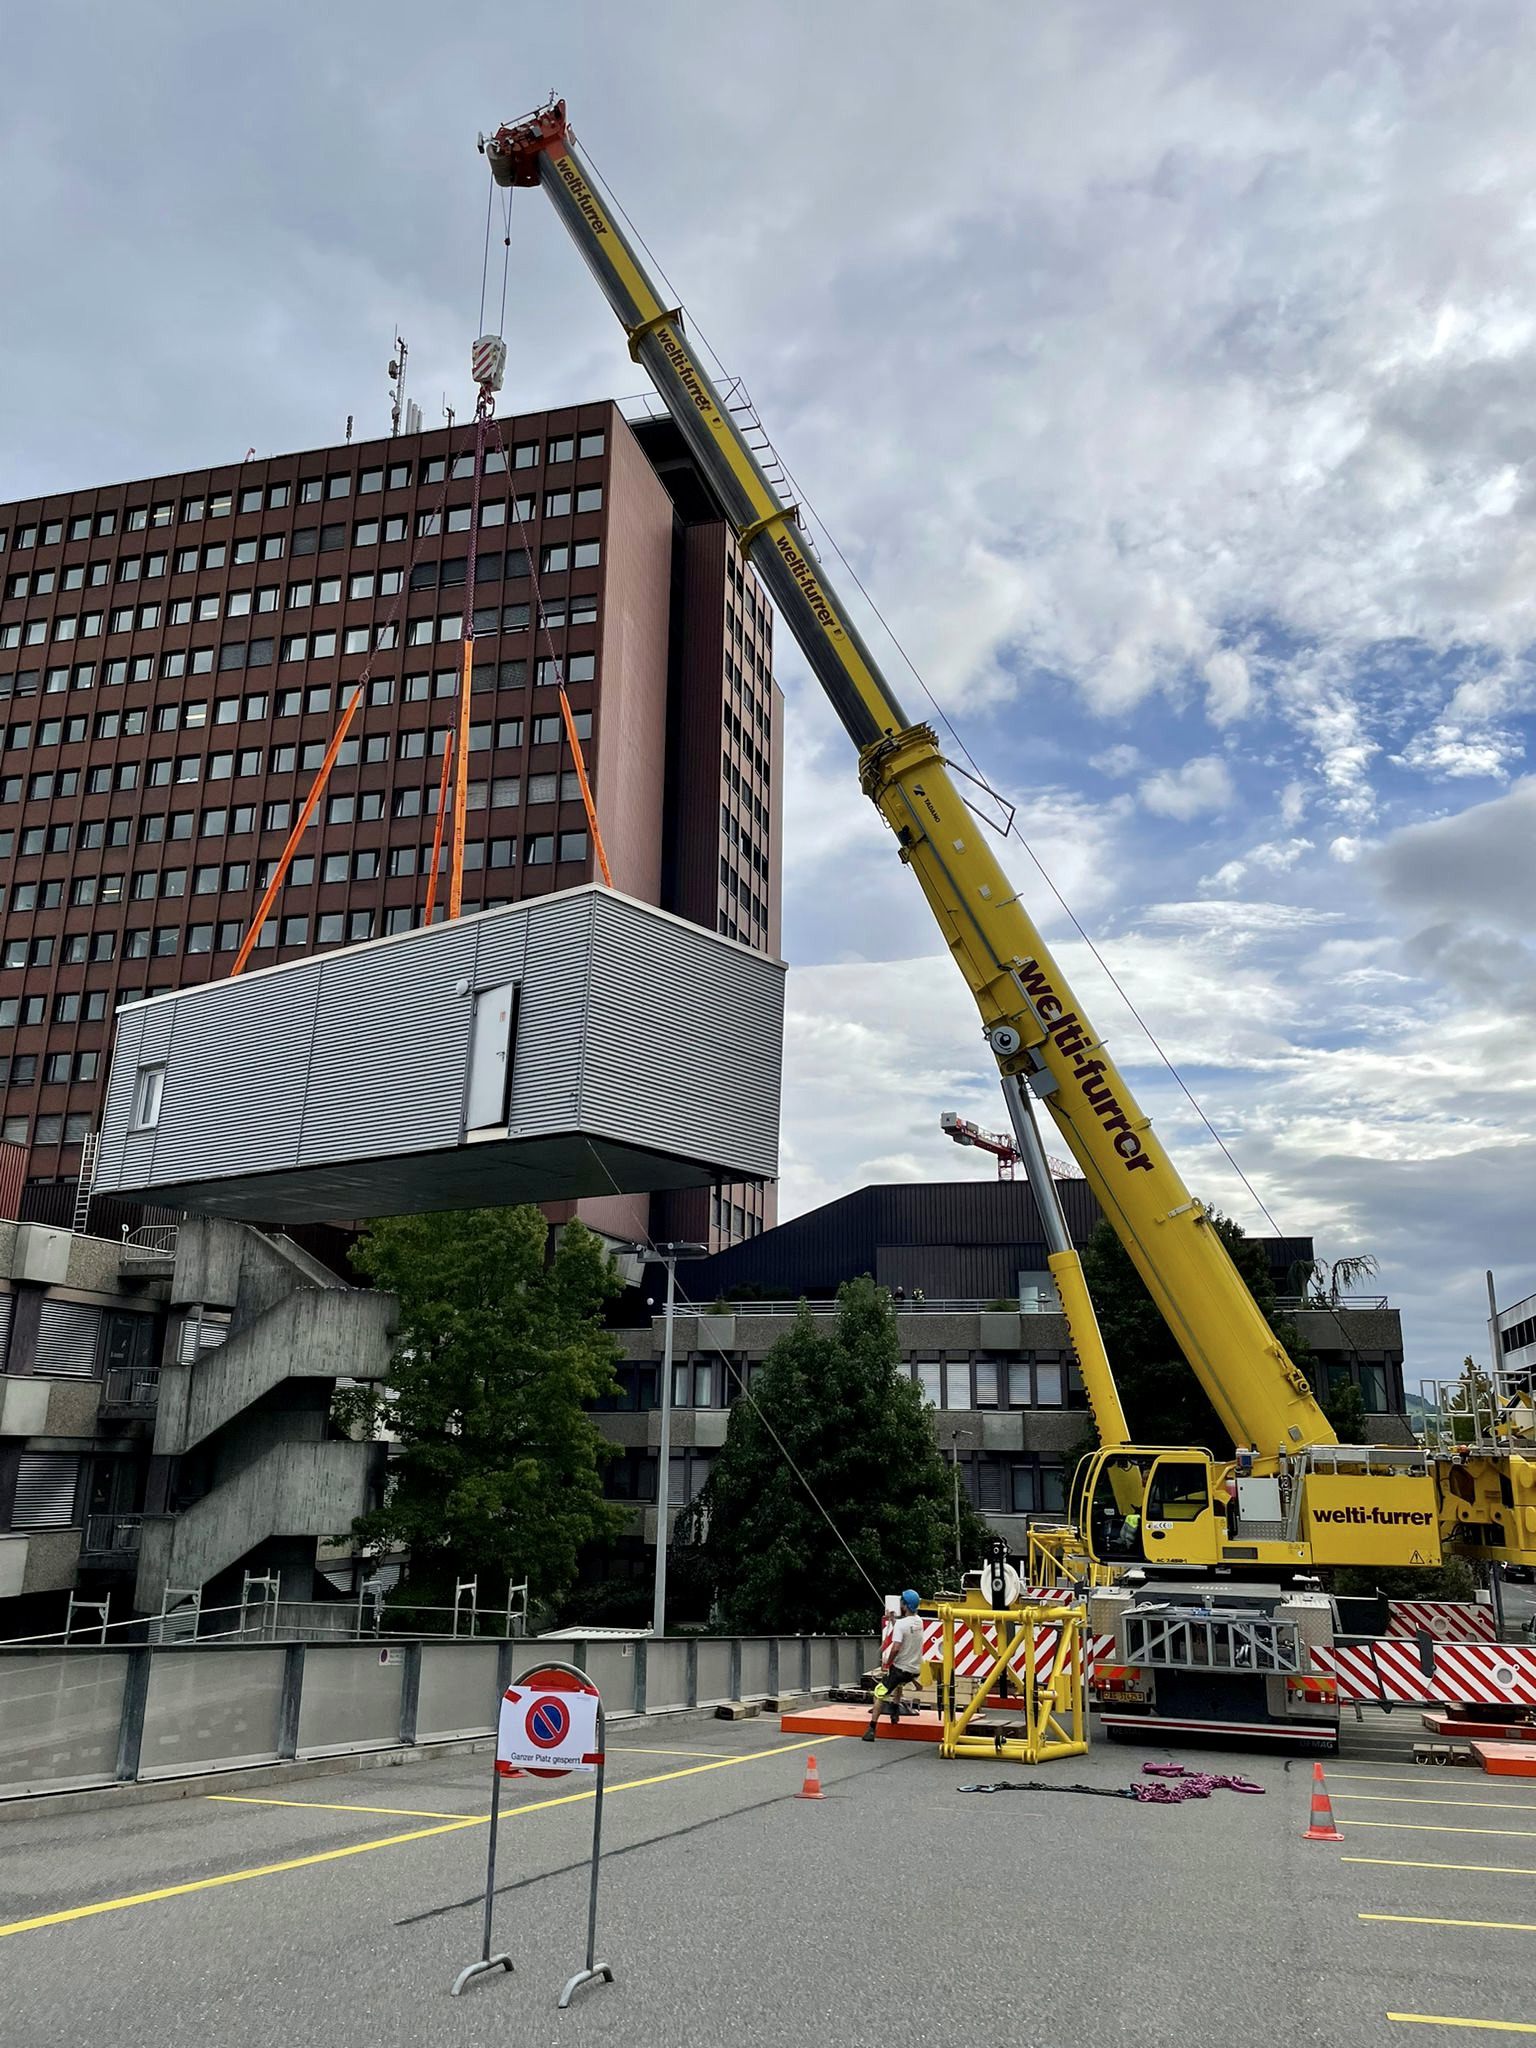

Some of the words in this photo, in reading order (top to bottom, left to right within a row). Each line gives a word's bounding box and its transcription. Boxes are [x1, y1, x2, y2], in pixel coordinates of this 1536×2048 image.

[556, 158, 608, 235] welti-furrer
[656, 327, 711, 412] welti-furrer
[776, 535, 836, 628] welti-furrer
[924, 798, 941, 823] TADANO
[1016, 959, 1155, 1172] welti-furrer
[1312, 1506, 1433, 1526] welti-furrer
[510, 1752, 534, 1761] Ganzer
[535, 1754, 551, 1762] Platz
